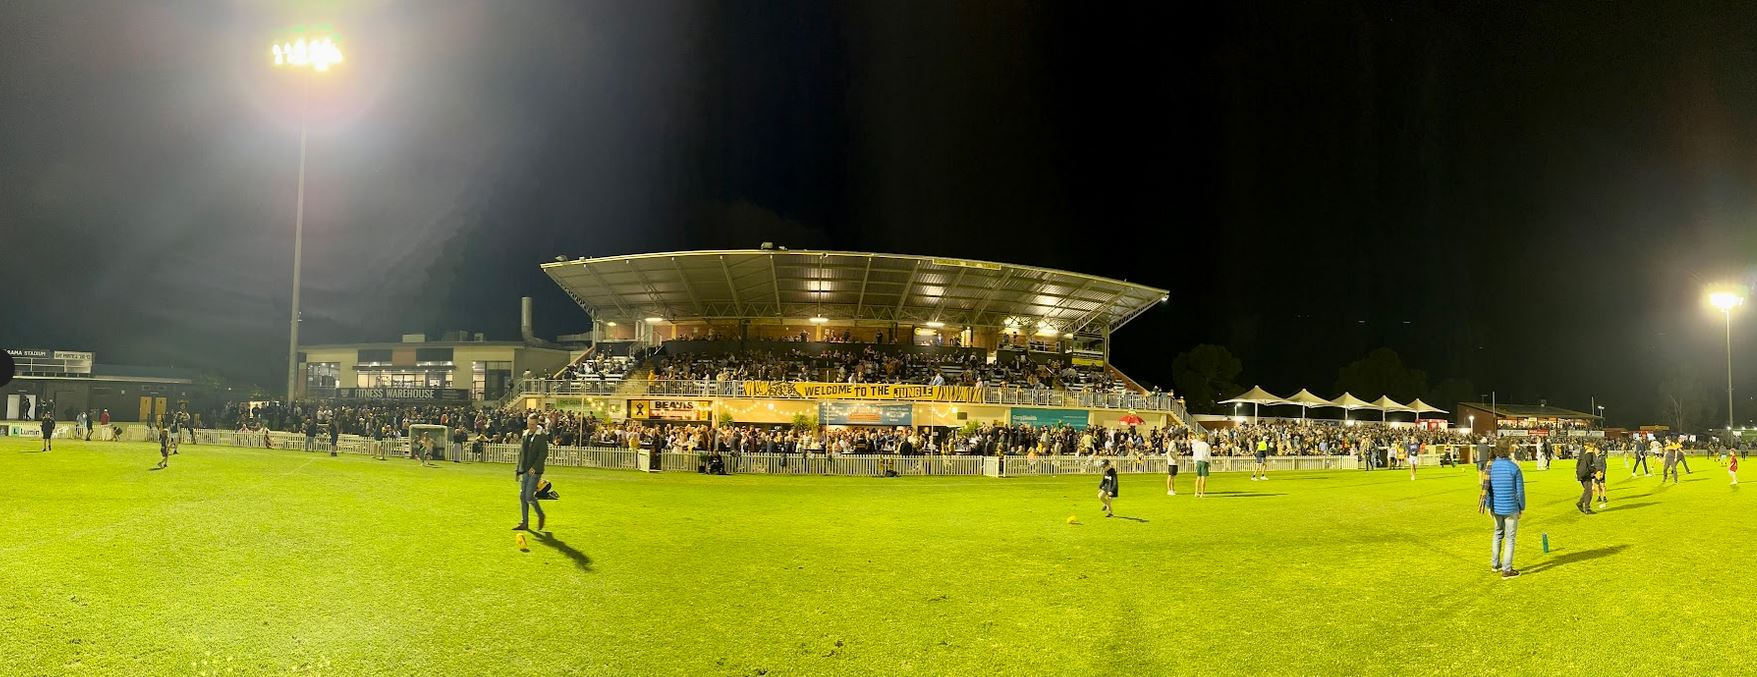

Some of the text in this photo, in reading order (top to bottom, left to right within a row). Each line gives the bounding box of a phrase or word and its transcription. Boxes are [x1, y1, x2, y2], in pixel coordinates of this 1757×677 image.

[355, 389, 383, 398] FITNESS
[386, 389, 435, 399] WAREHOUSE
[804, 385, 933, 398] WELCOME TO THE JUNGLE
